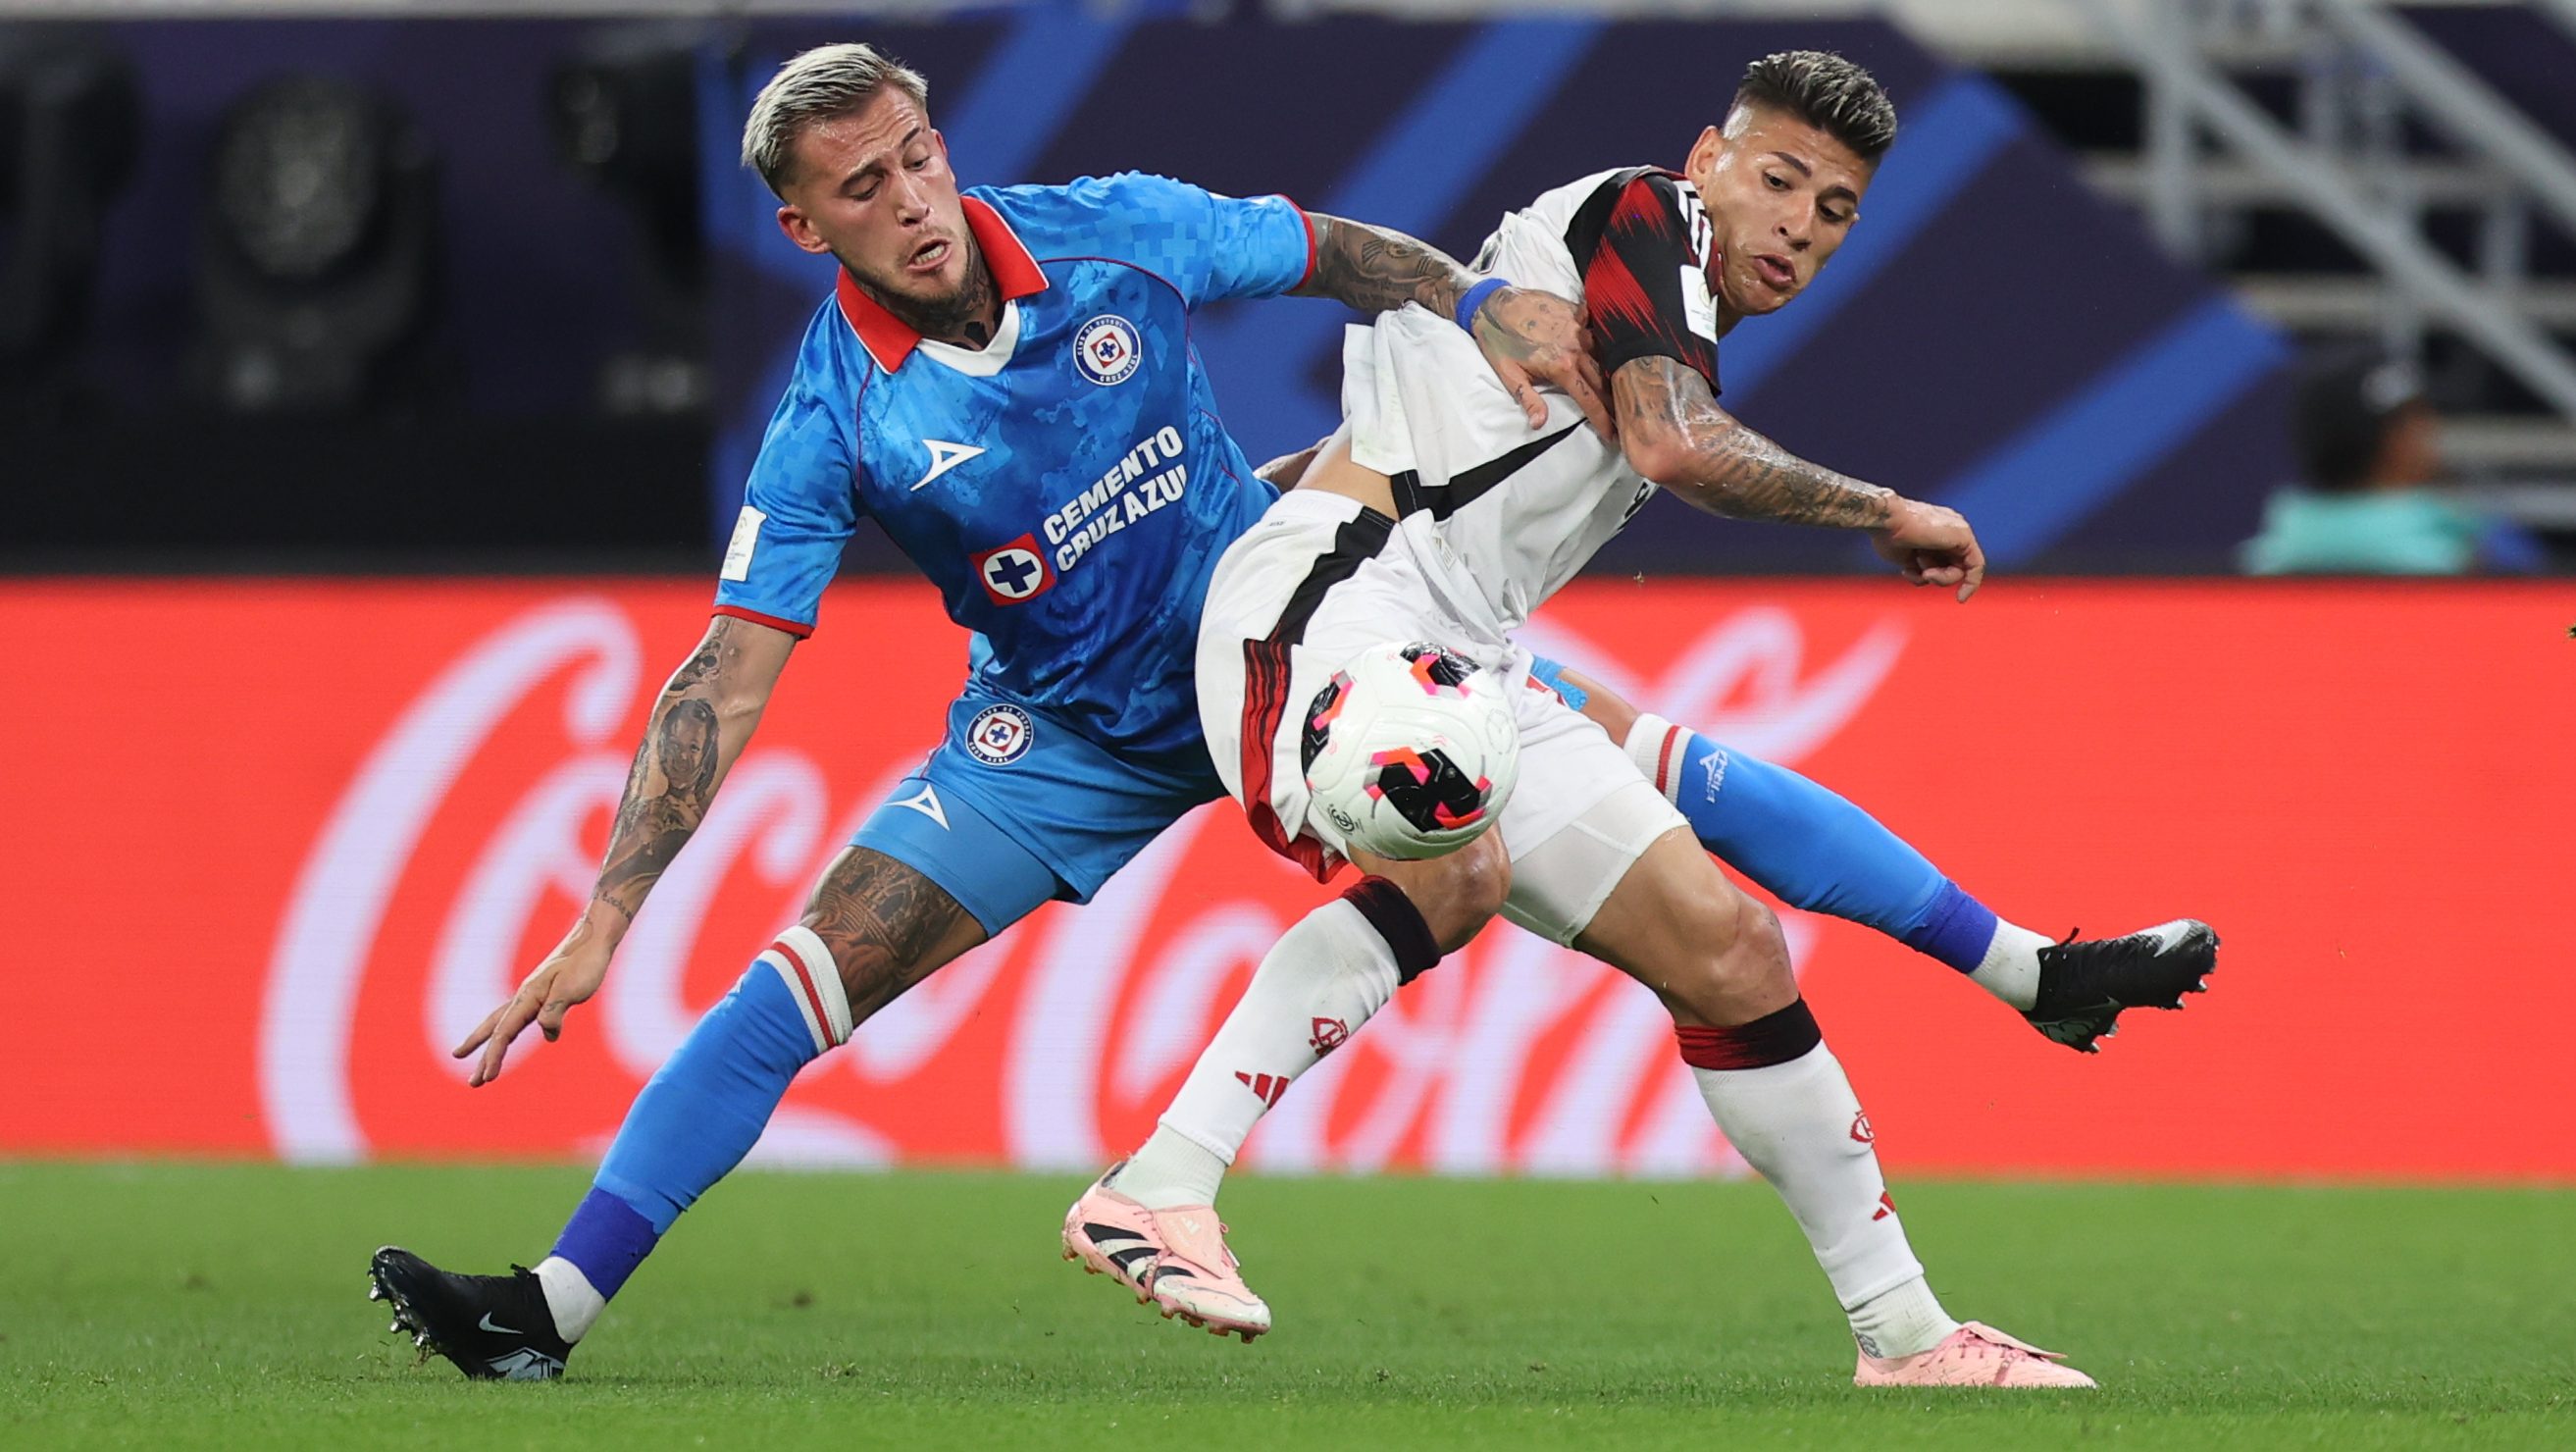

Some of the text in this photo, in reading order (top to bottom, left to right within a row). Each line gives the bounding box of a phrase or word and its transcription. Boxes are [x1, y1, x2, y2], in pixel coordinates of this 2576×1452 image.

[1100, 372, 1122, 384] CRUZ
[1043, 425, 1184, 545] CEMENTO
[1056, 504, 1126, 572] CRUZ
